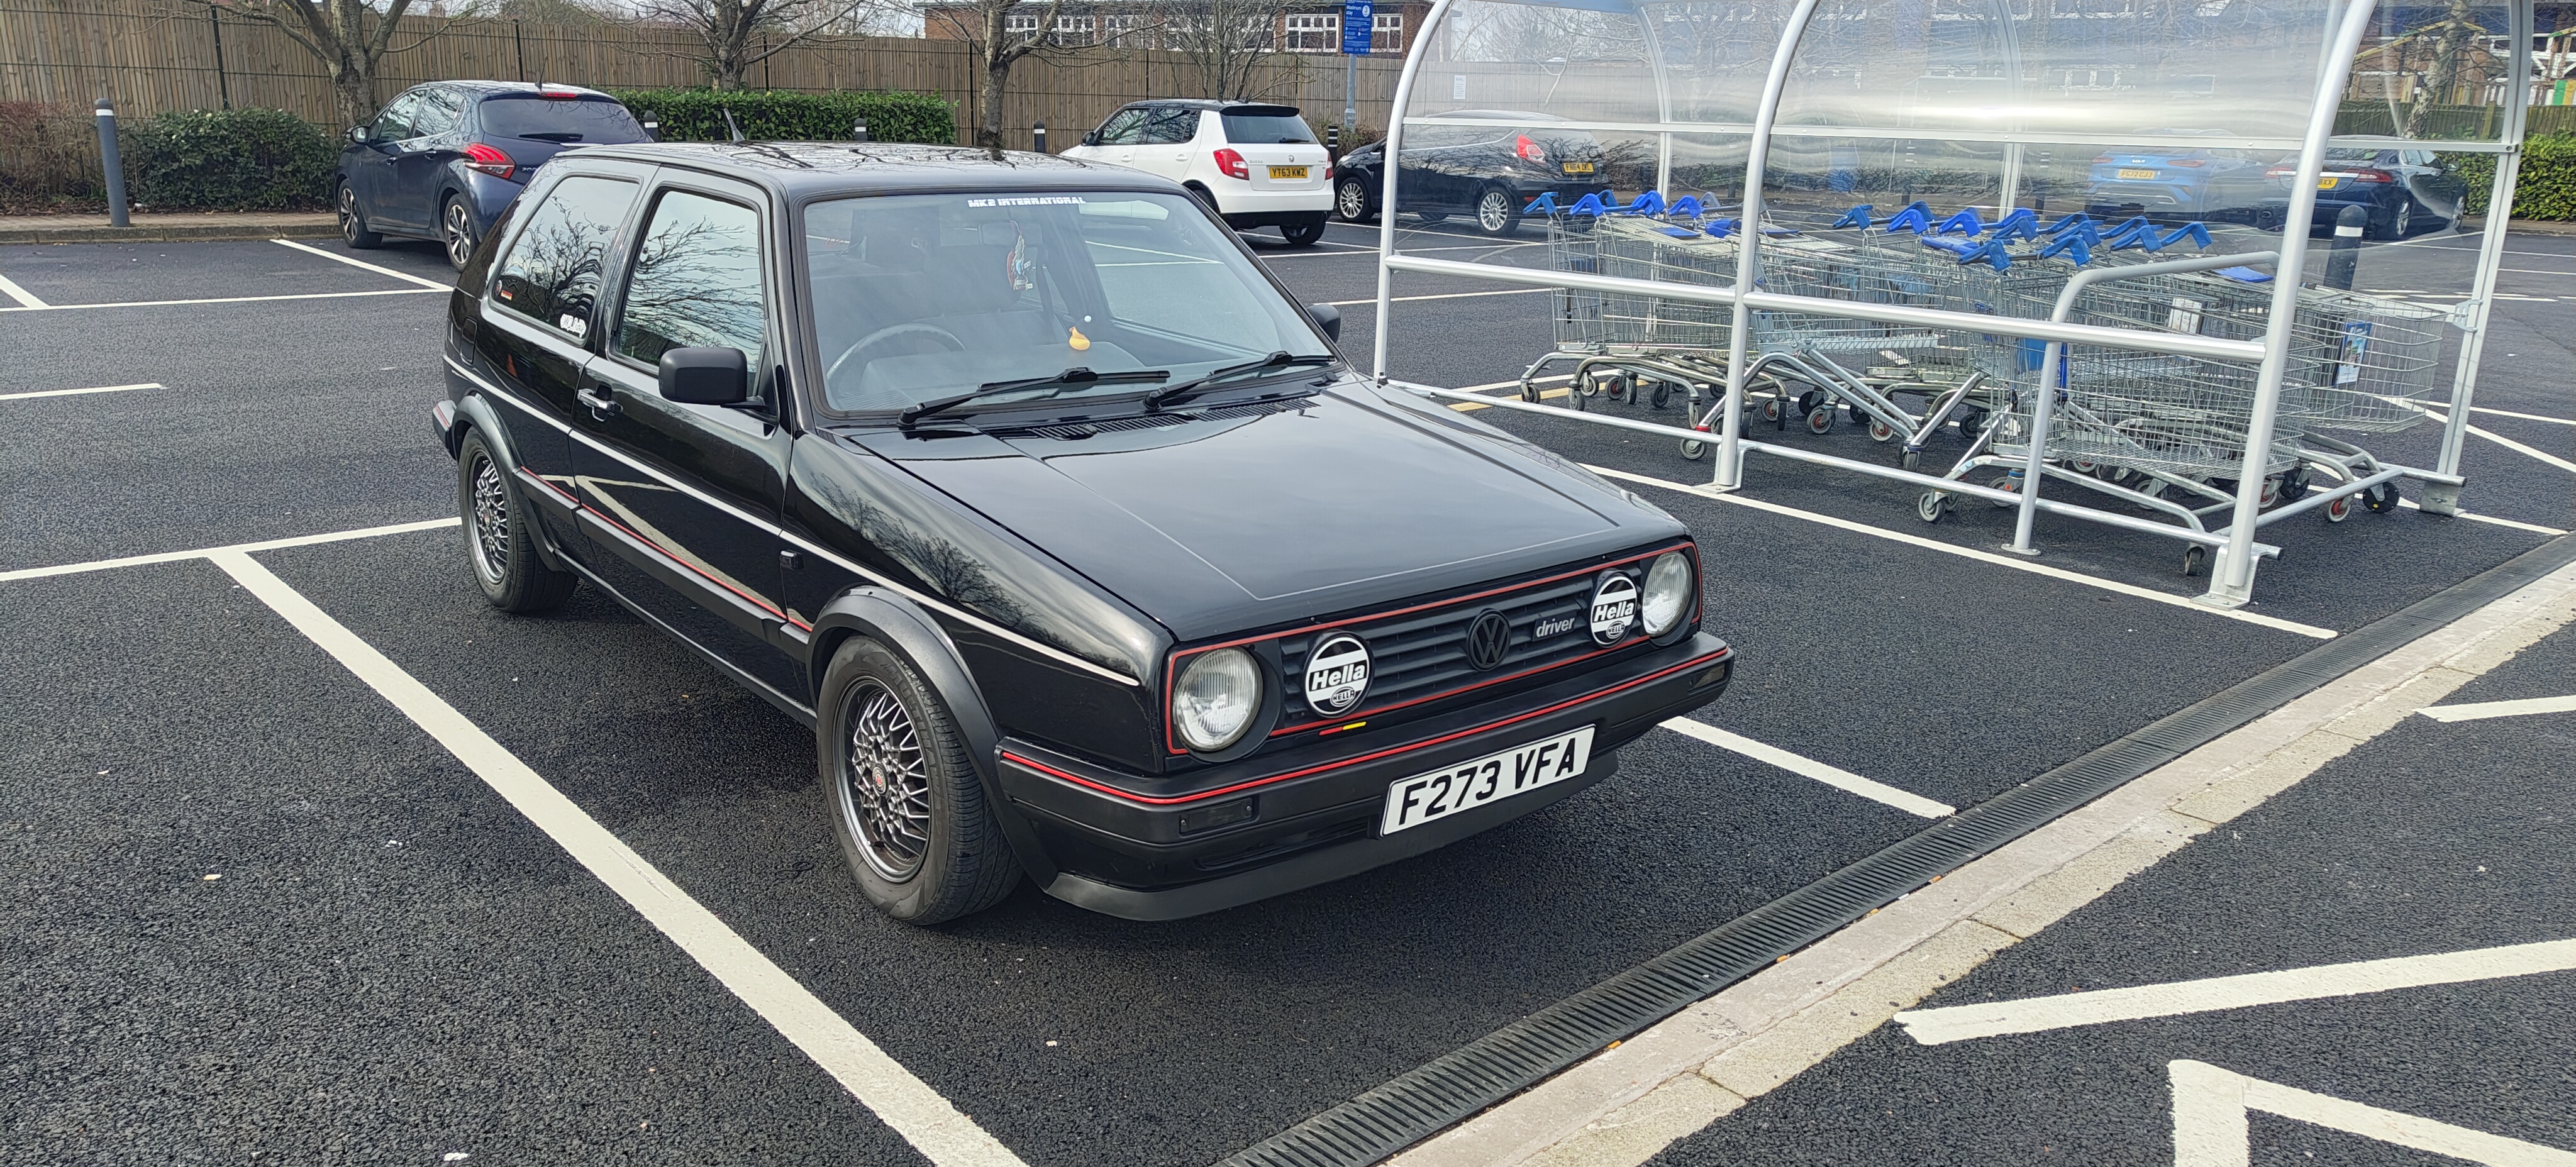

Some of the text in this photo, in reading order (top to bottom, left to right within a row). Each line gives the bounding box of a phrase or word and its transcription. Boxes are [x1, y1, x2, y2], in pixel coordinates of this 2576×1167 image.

[1272, 167, 1306, 177] YT63 KWZ
[967, 197, 1086, 207] MK2 INTERNATIONAL
[1594, 601, 1635, 622] Hella
[1536, 616, 1575, 638] driver
[1608, 624, 1625, 634] HELLA
[1311, 664, 1365, 690] Hella
[1333, 689, 1355, 702] HELLA
[1398, 737, 1576, 826] F273 VFA
